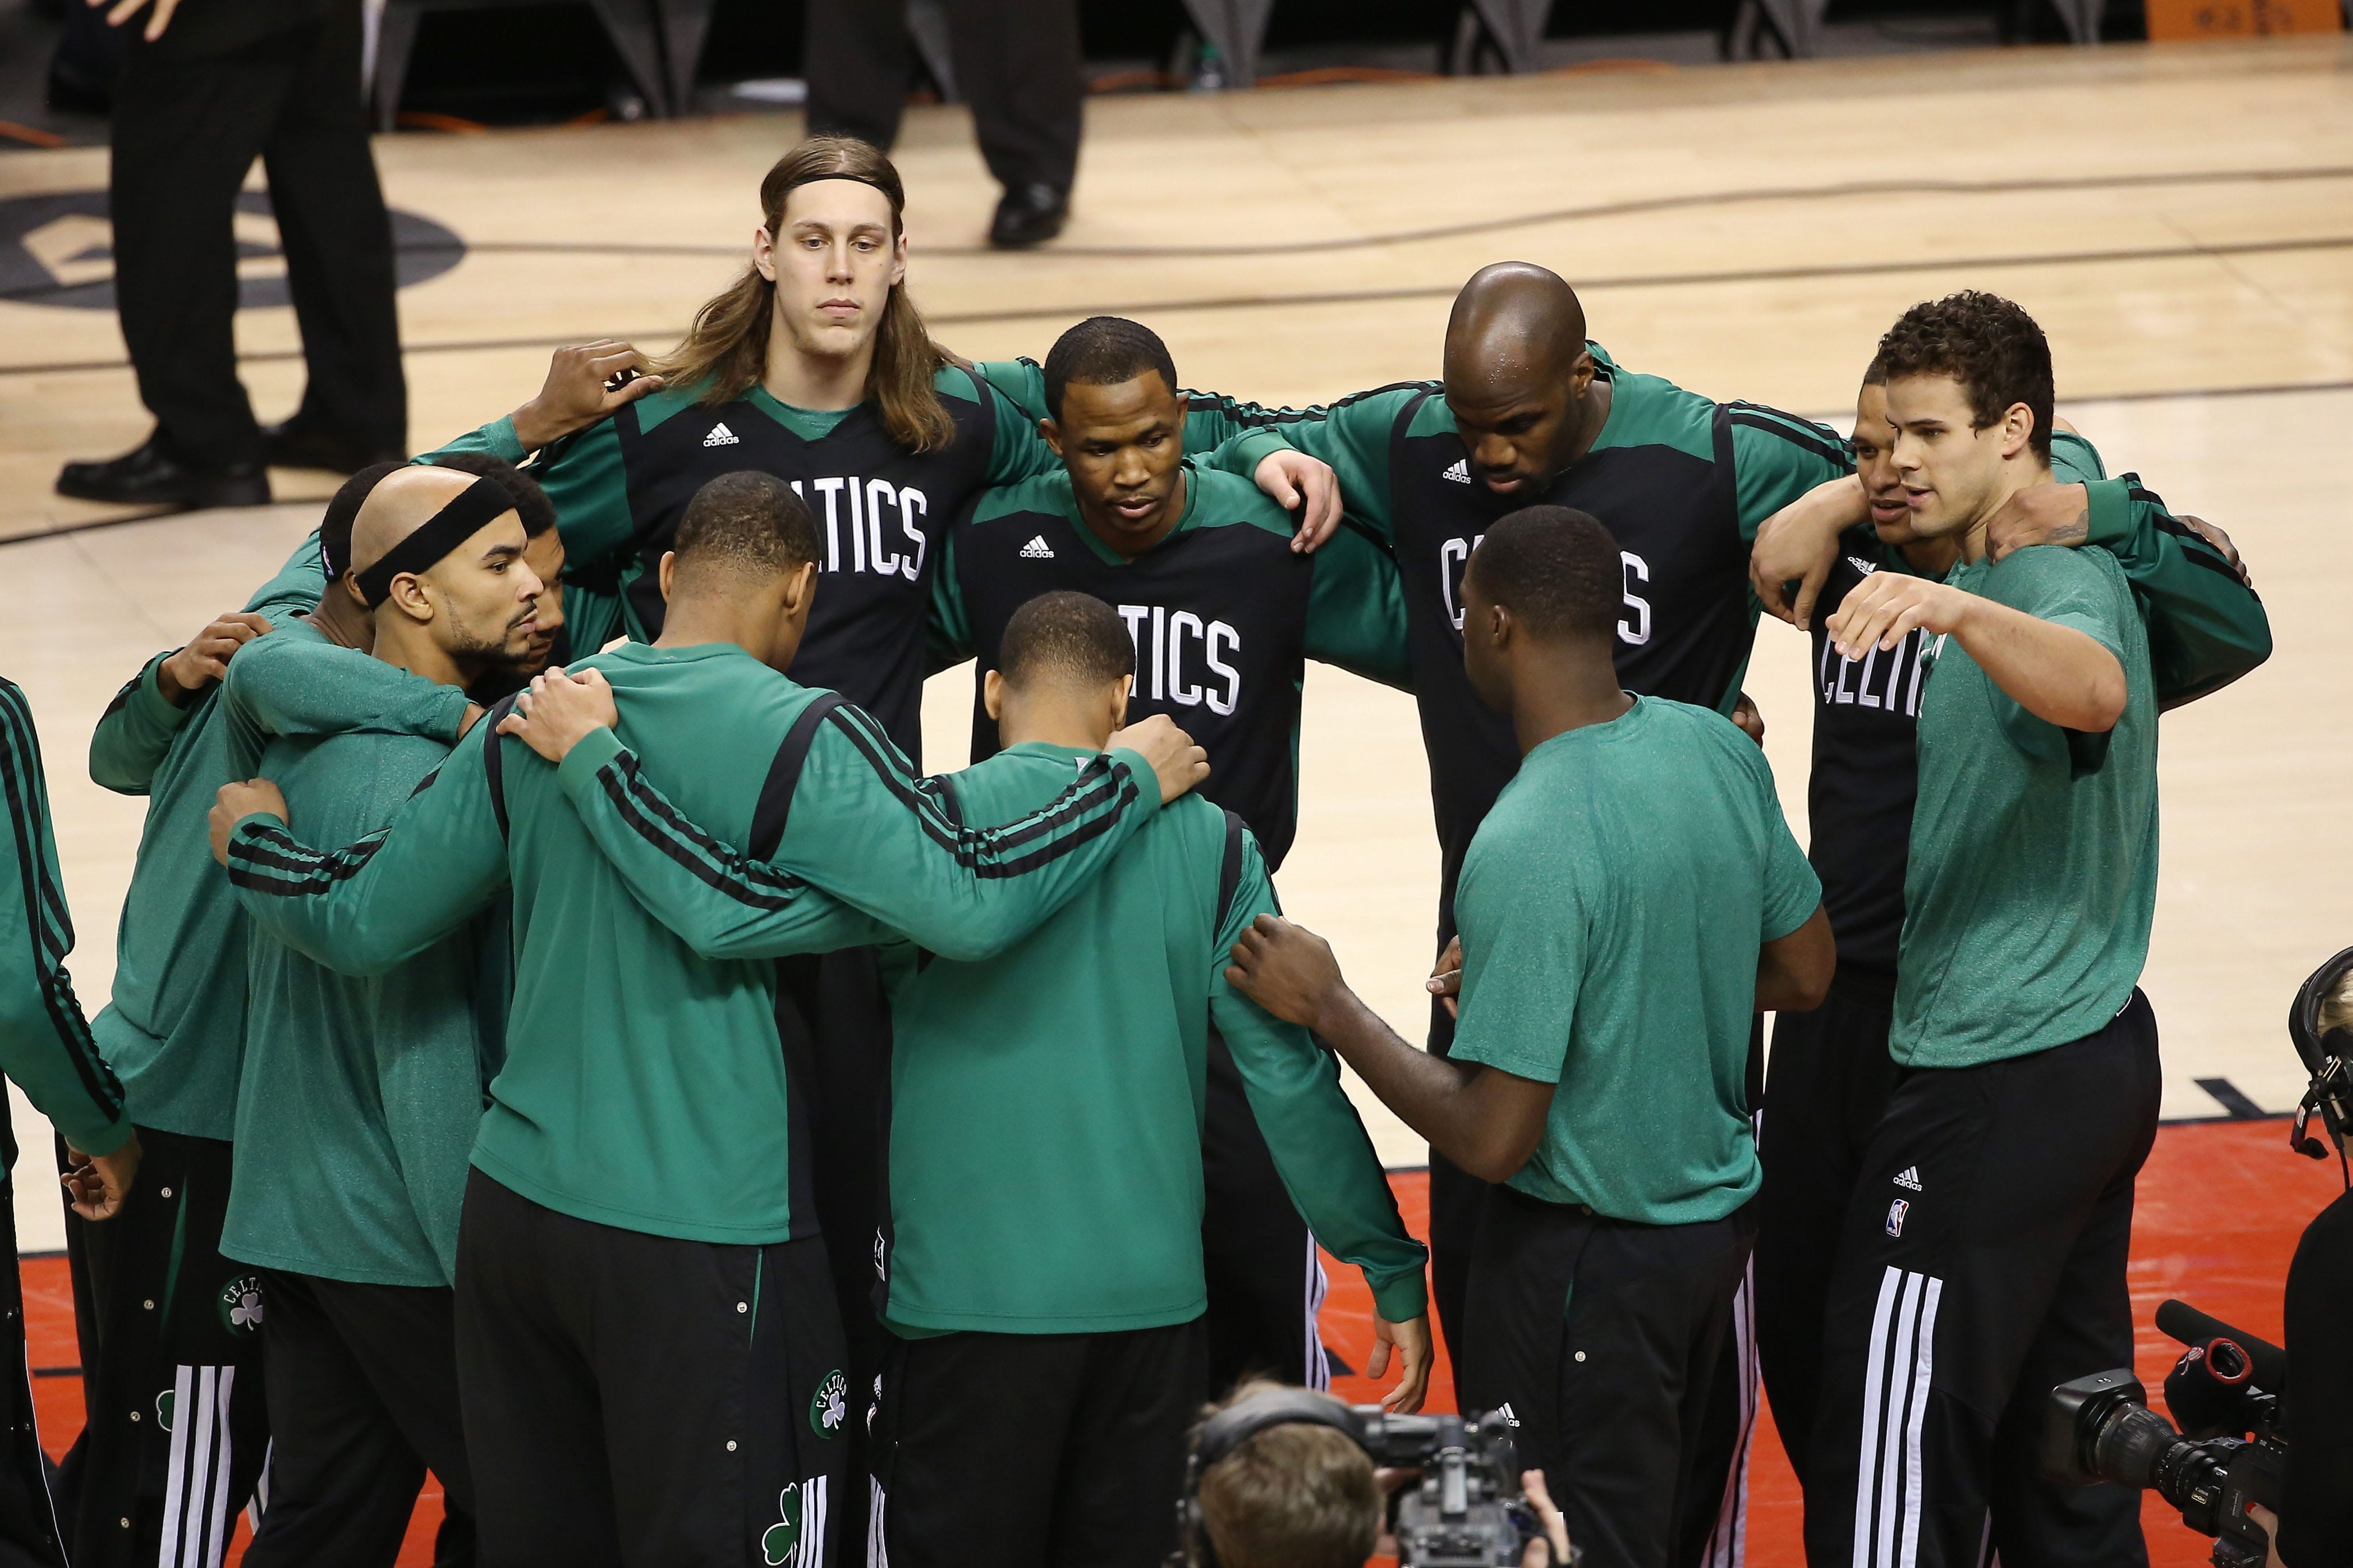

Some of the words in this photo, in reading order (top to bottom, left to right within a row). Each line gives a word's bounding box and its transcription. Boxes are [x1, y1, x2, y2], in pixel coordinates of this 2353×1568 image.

[703, 435, 740, 447] adidas
[1442, 470, 1471, 484] adidas
[790, 476, 927, 582] TICS
[1019, 549, 1055, 558] adidas
[1117, 605, 1240, 716] TICS
[1893, 1177, 1923, 1192] adidas
[223, 1277, 263, 1304] CELT
[816, 1375, 847, 1409] CELTICS
